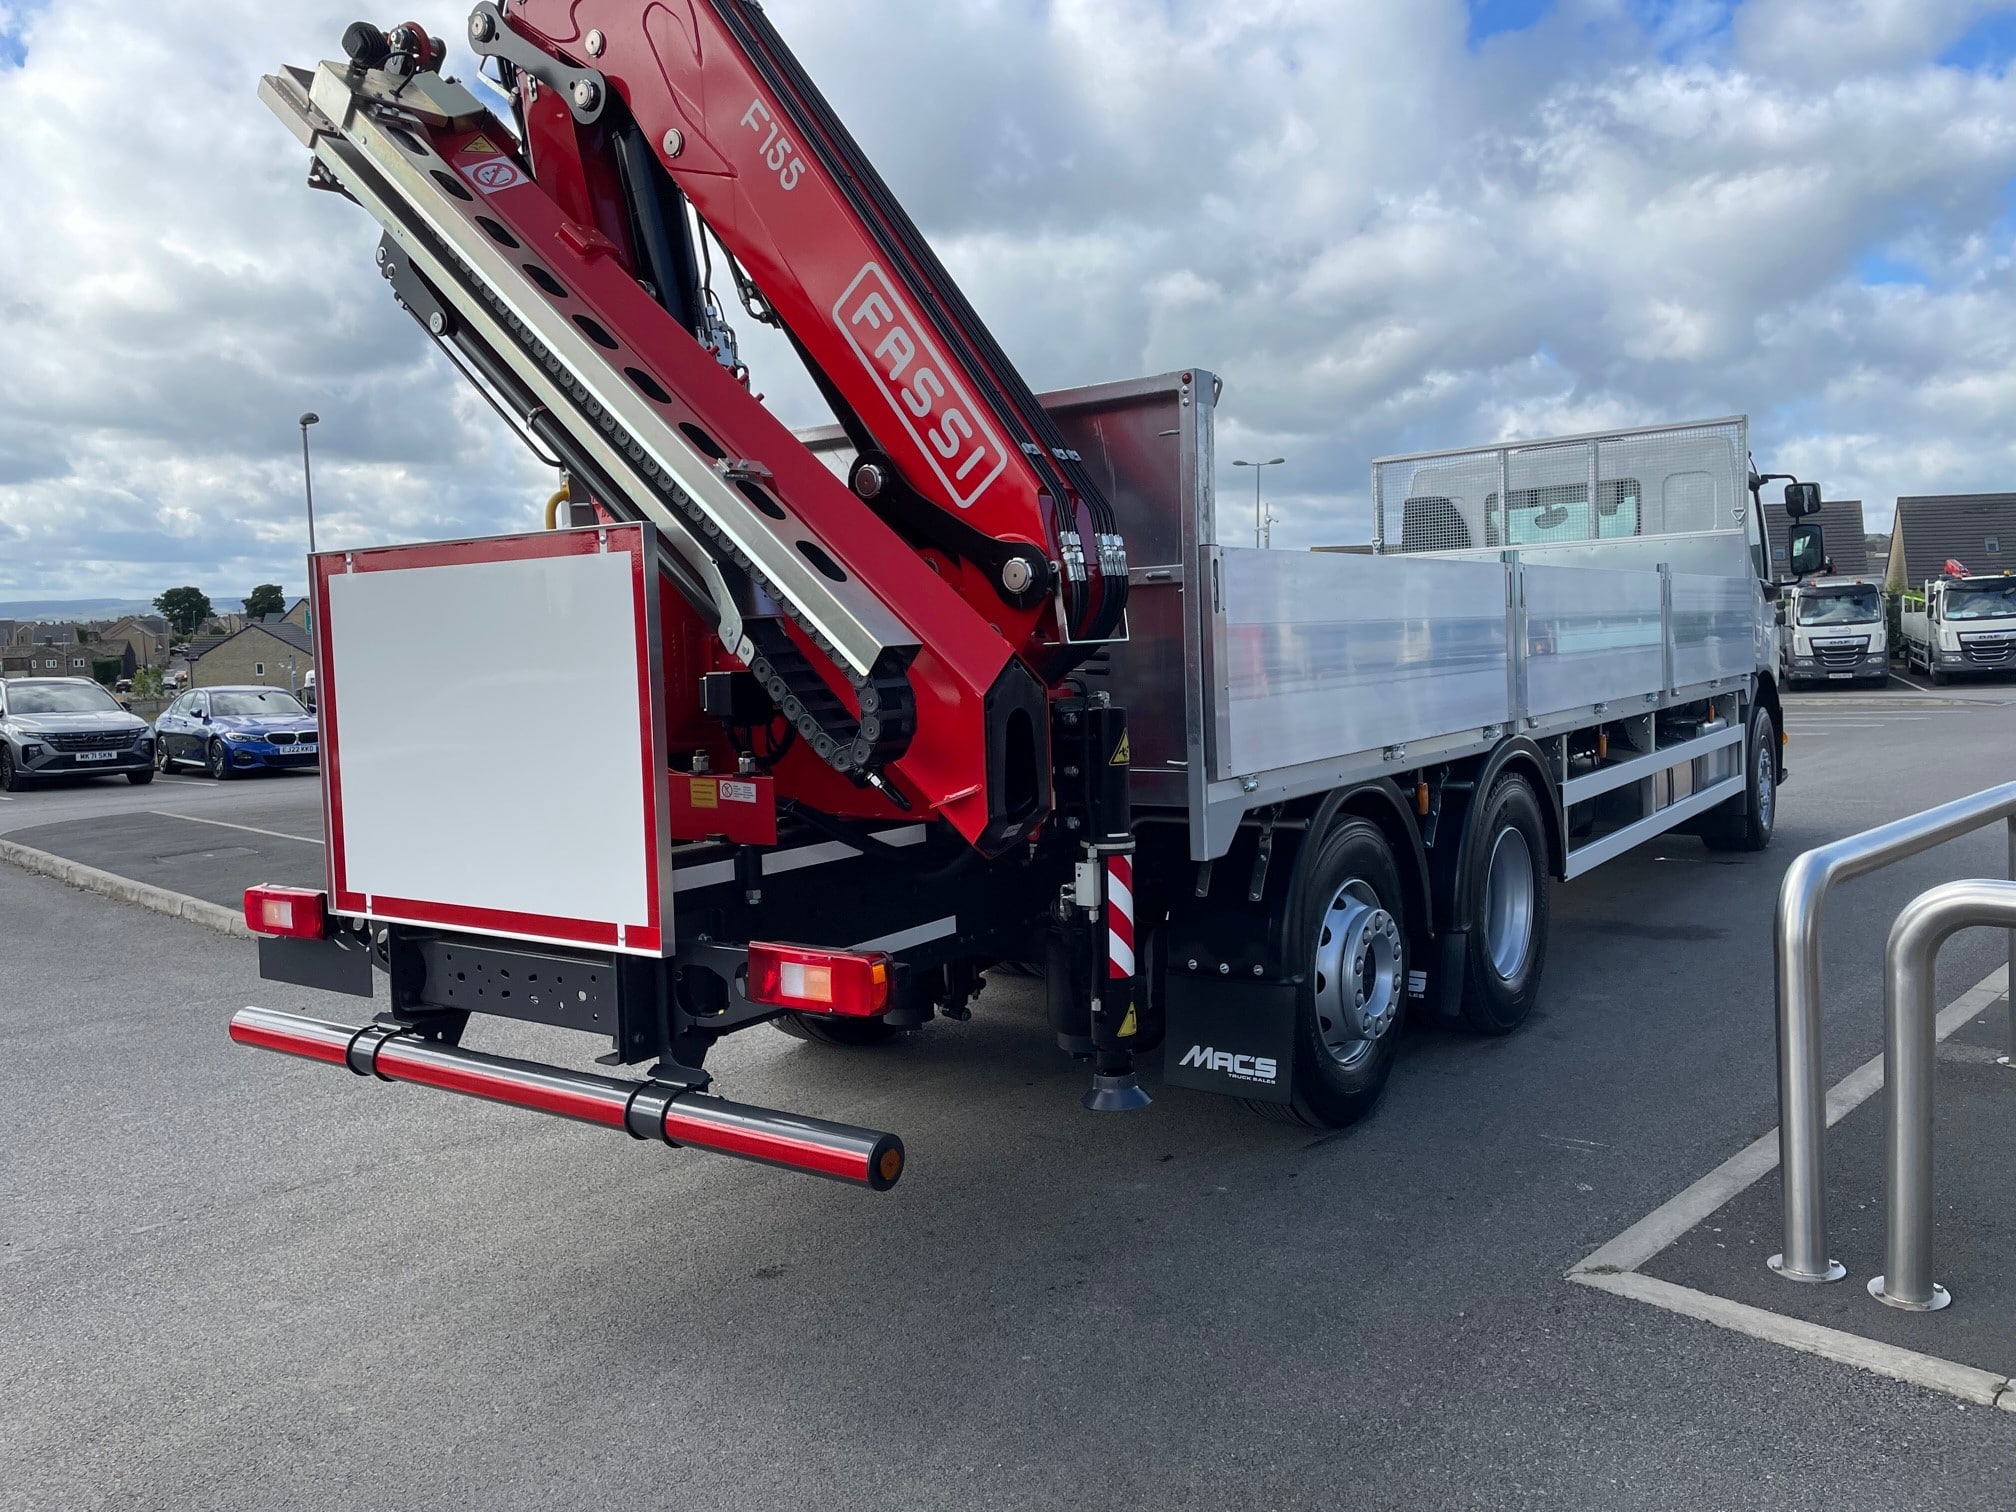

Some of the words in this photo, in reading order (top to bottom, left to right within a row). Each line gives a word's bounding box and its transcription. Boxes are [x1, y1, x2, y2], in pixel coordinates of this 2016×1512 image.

[740, 98, 806, 191] F155
[852, 291, 986, 481] FASSI
[1227, 1073, 1252, 1081] TRUCK
[1252, 1077, 1276, 1085] SALES
